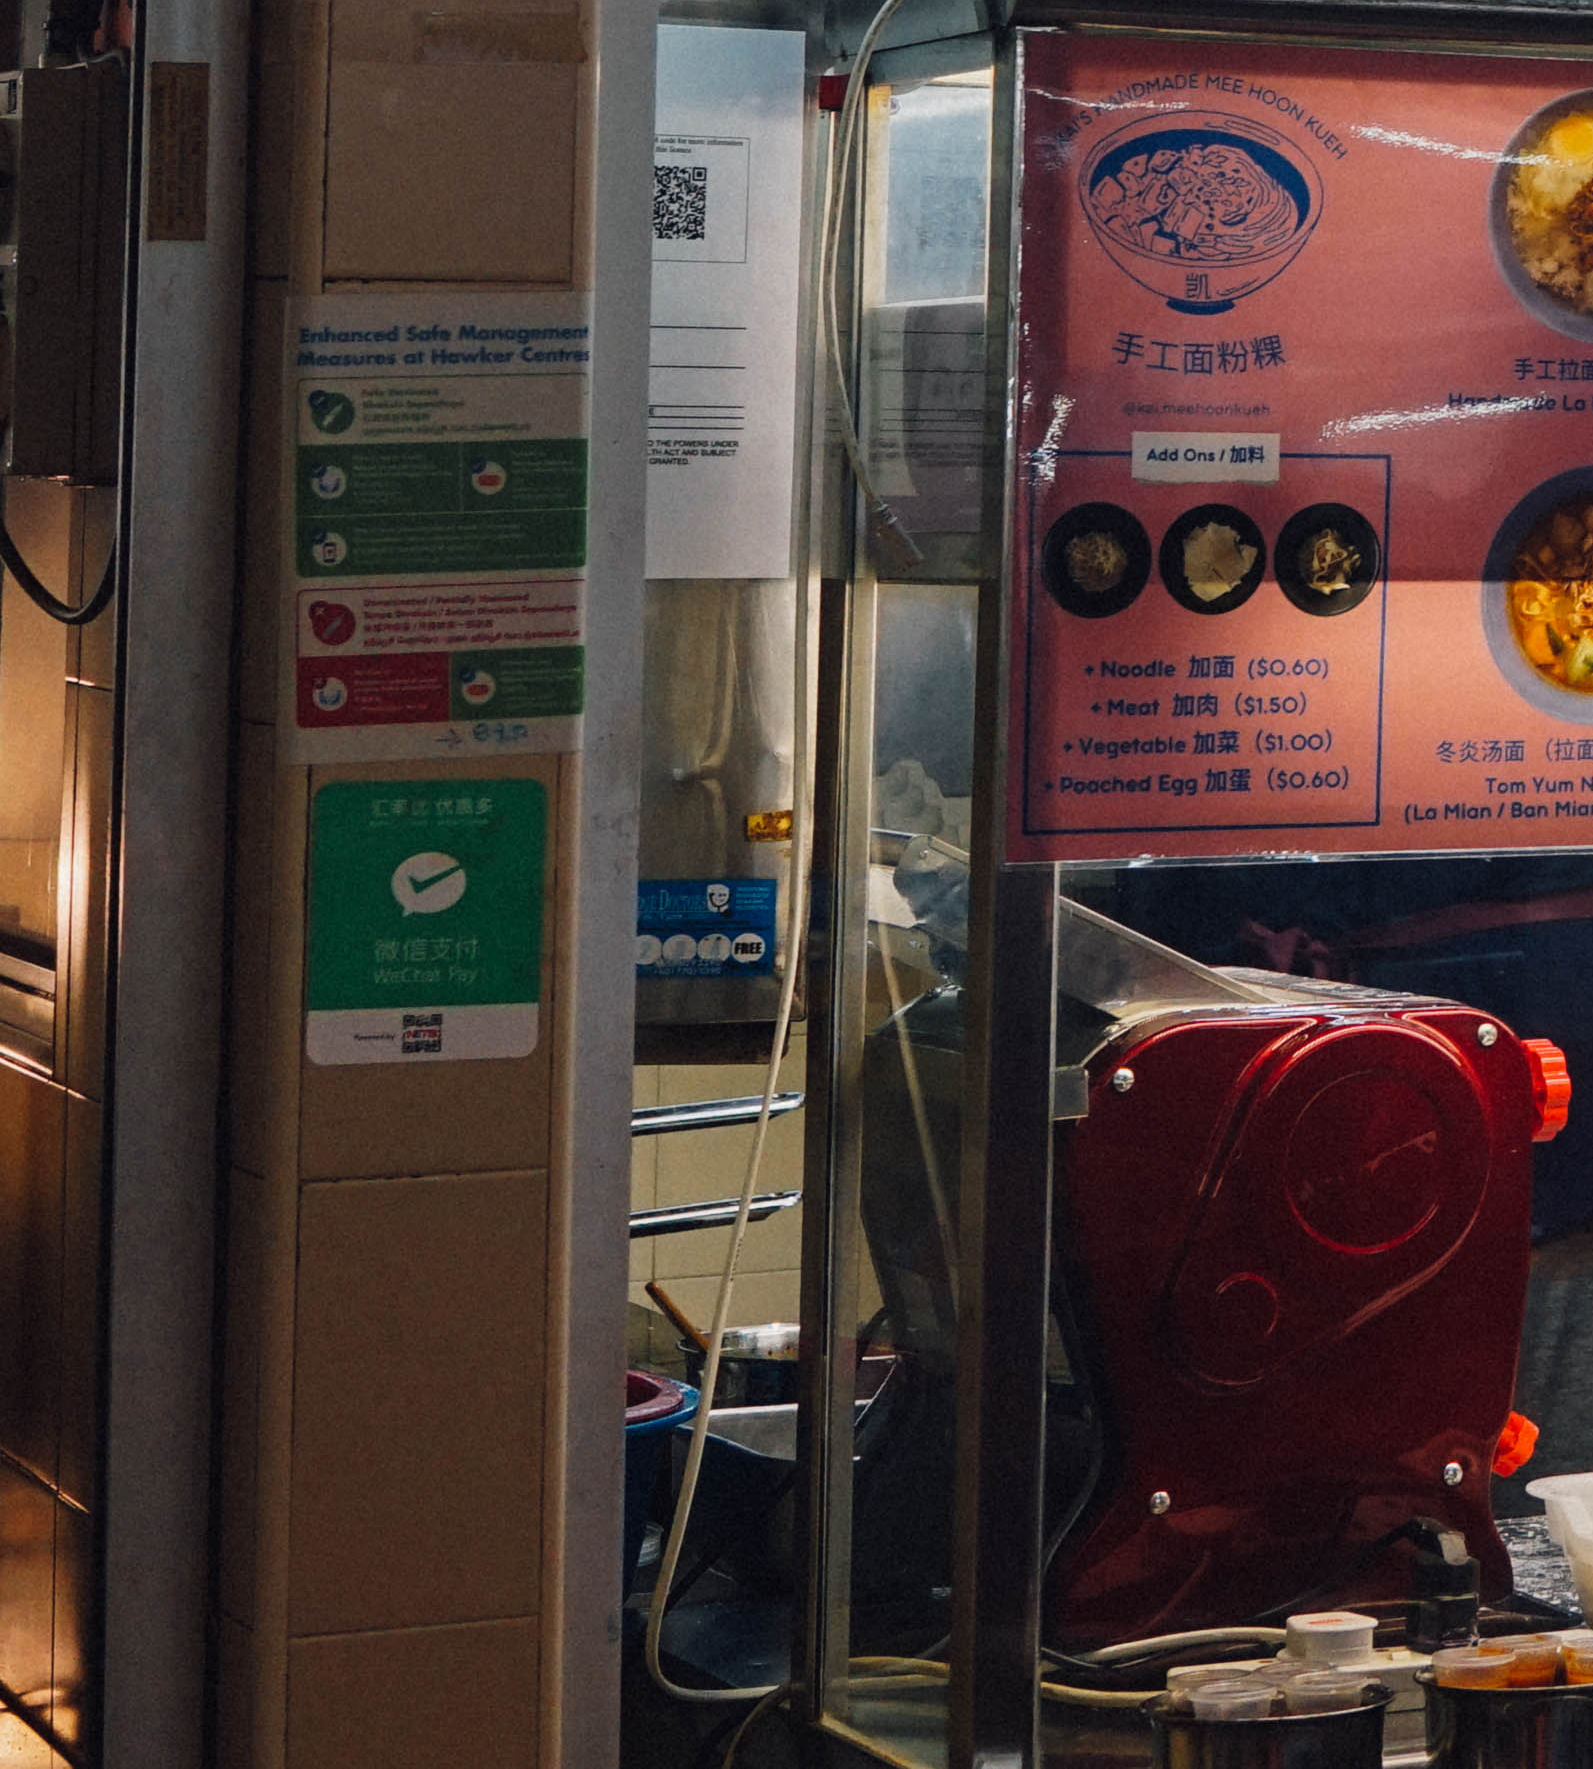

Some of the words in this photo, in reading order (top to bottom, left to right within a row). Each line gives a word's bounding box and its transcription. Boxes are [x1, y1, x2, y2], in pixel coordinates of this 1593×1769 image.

[1205, 75, 1245, 96] MEE
[1248, 86, 1305, 121] HOON
[1305, 117, 1349, 161] KUEH
[298, 325, 399, 344] Enhanced
[407, 324, 452, 343] Safe
[296, 349, 396, 367] Measures
[403, 350, 424, 365] at
[431, 346, 514, 365] Hawker
[1112, 332, 1286, 375] 手工面粉粿
[1563, 397, 1587, 413] La
[1146, 449, 1179, 462] Add
[1184, 449, 1216, 463] Ons
[1230, 445, 1266, 464] 加料
[1100, 661, 1176, 678] Noodle
[1187, 655, 1236, 679] 加面
[1248, 658, 1330, 680] ($0.60)
[1107, 699, 1160, 716] Meat
[1171, 693, 1218, 718] 加肉
[1234, 692, 1307, 717] ($1.50)
[1079, 737, 1187, 760] Vegetable
[1192, 730, 1240, 755] 加菜
[1255, 729, 1333, 755] ($1.00)
[1436, 739, 1526, 764] 冬炎汤面
[1060, 776, 1152, 794] Poached
[1158, 775, 1199, 796] Egg
[1204, 768, 1252, 793] 加蛋
[1266, 766, 1350, 792] ($0.60)
[1485, 777, 1526, 795] Tom
[1532, 777, 1575, 794] Yum
[1404, 804, 1438, 824] (La
[1444, 801, 1492, 821] Mian
[1511, 800, 1548, 819] Ban
[734, 941, 763, 955] FREE
